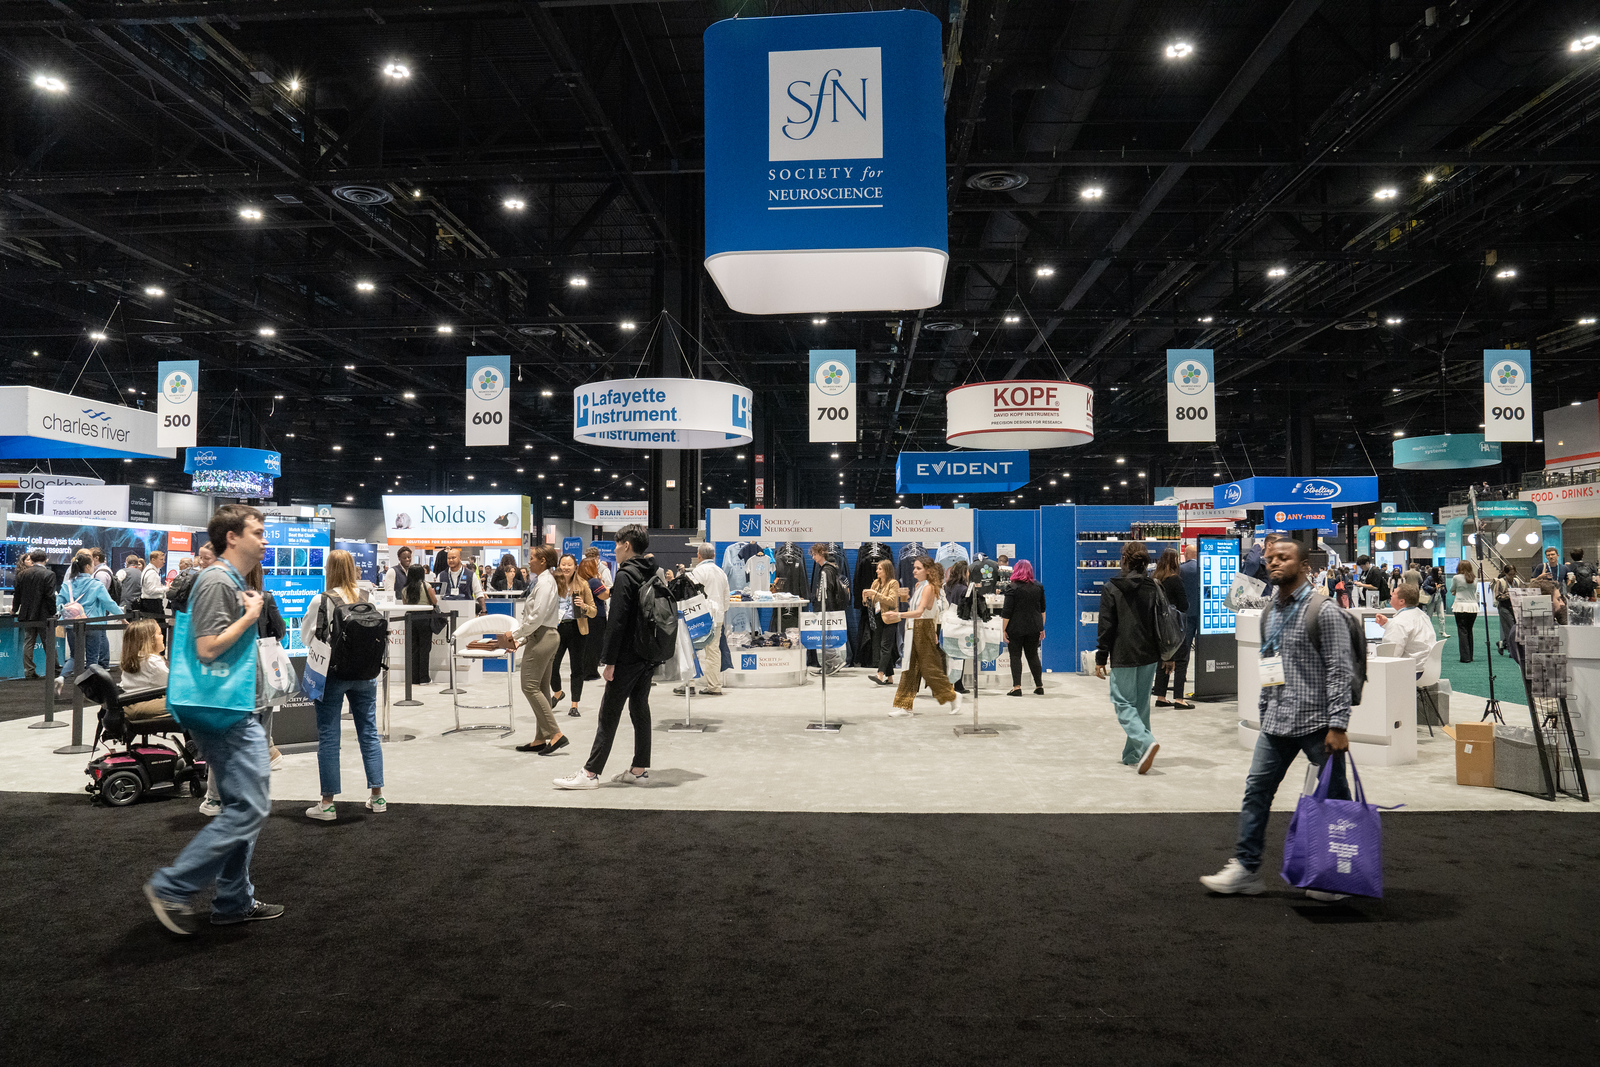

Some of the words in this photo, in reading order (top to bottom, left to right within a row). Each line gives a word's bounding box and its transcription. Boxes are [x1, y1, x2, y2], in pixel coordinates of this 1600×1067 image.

[782, 68, 868, 141] SfN
[768, 166, 853, 181] SOCIETY
[860, 166, 884, 181] for
[768, 187, 883, 201] NEUROSCIENCE
[592, 388, 666, 407] Lafayette
[472, 411, 503, 425] 600
[817, 406, 849, 420] 700
[1175, 406, 1208, 420] 800
[1491, 406, 1525, 420] 900
[42, 413, 99, 438] charles
[101, 423, 130, 442] river
[163, 414, 191, 427] 500
[917, 461, 1013, 476] EVIDENT
[1531, 492, 1554, 502] FOOD
[1562, 487, 1593, 499] DRINKS
[420, 505, 486, 523] Noldus
[43, 537, 67, 546] analysis
